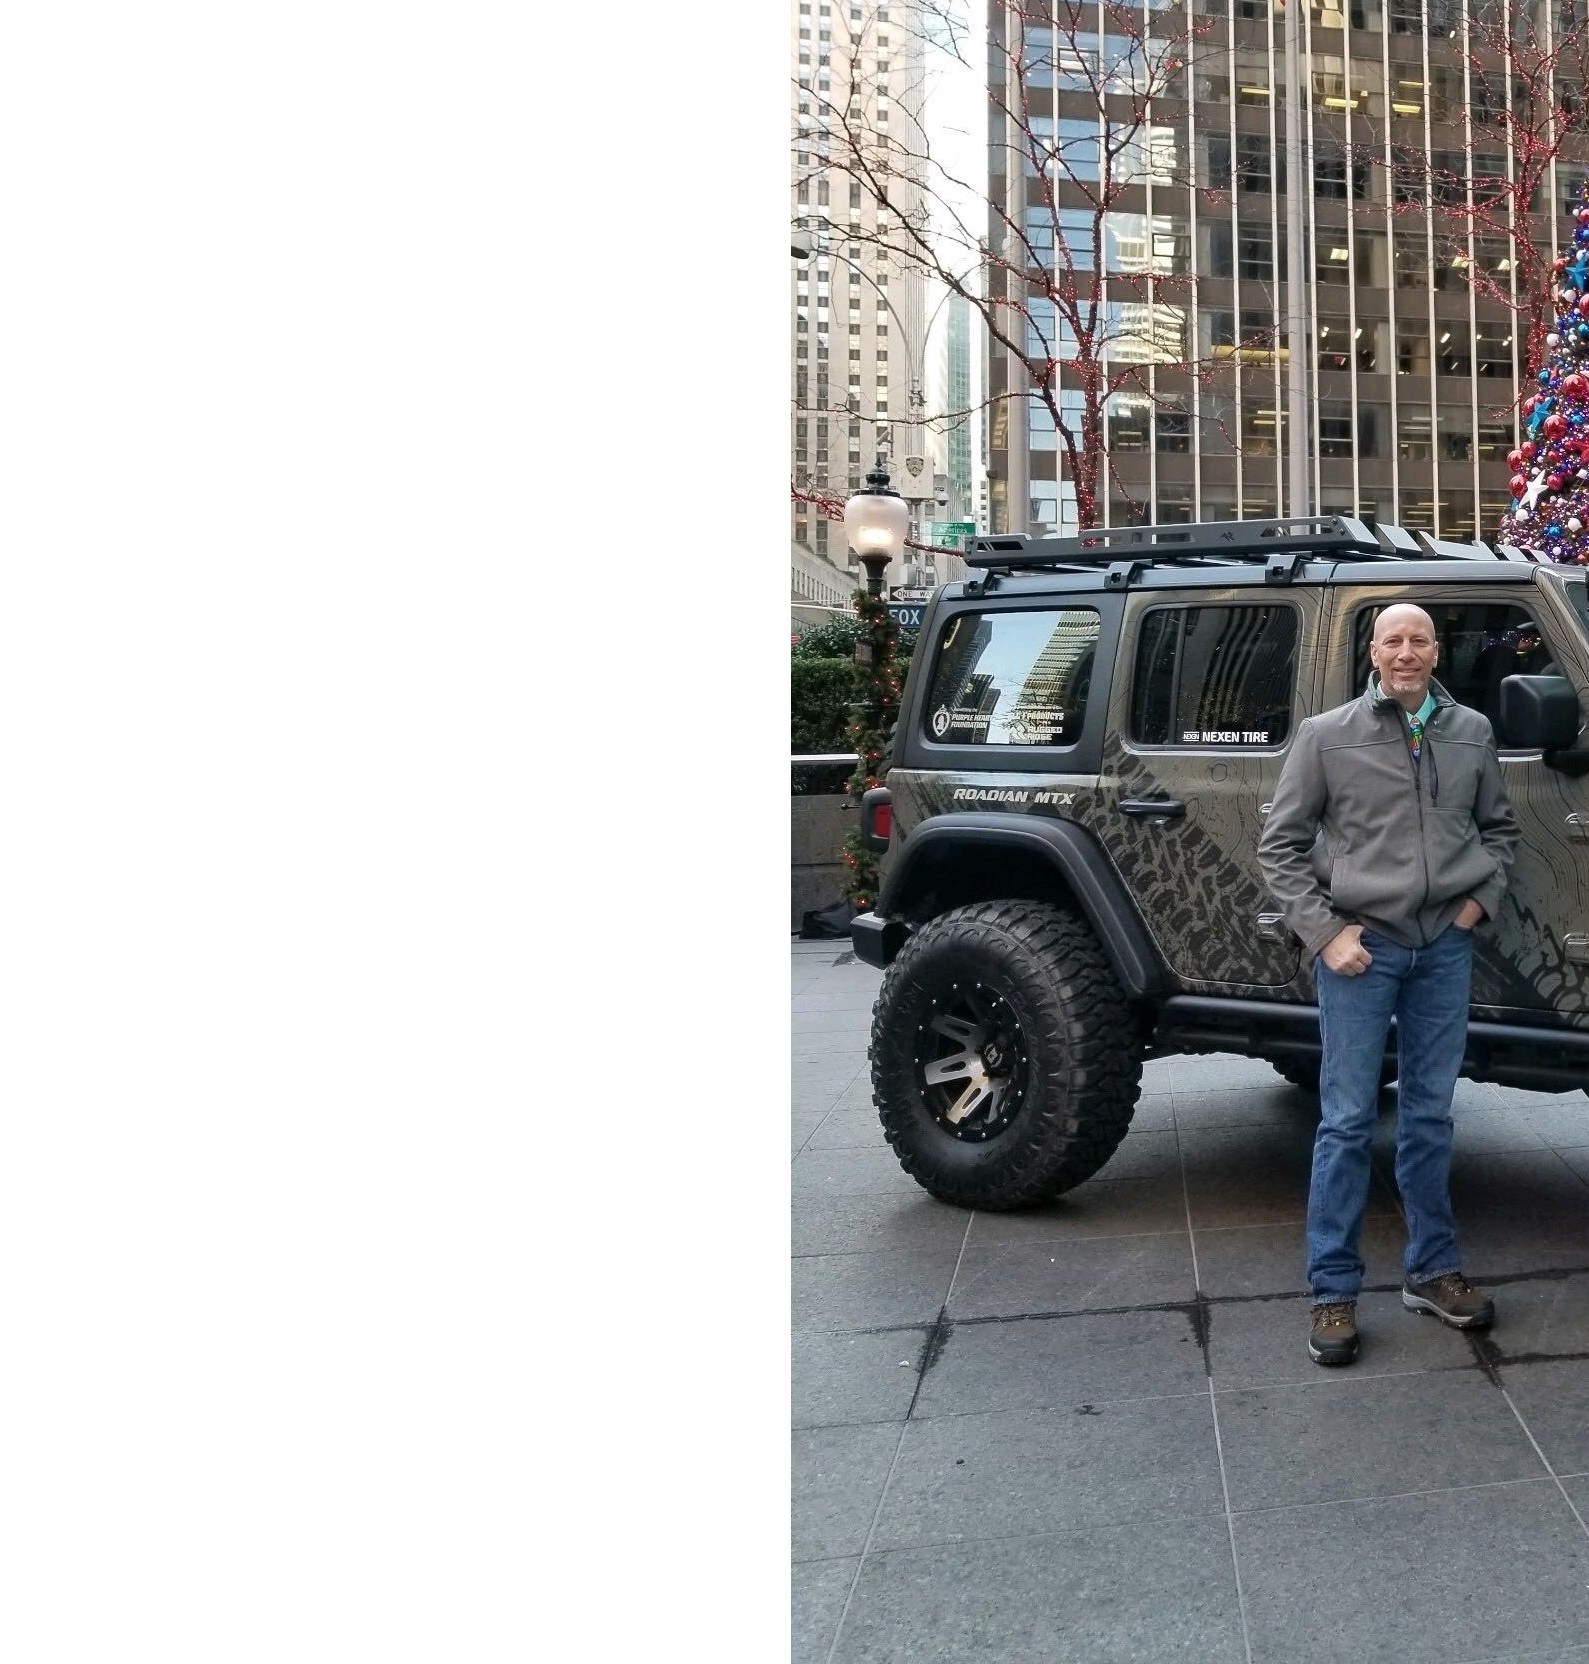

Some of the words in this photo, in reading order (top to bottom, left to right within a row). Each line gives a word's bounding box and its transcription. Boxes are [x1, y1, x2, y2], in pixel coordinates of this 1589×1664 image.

[951, 713, 974, 721] PURPLE
[1202, 731, 1239, 742] NEXEN
[1242, 731, 1268, 742] TIRE
[953, 788, 1028, 802] ROADIAN
[1034, 792, 1076, 804] MTX
